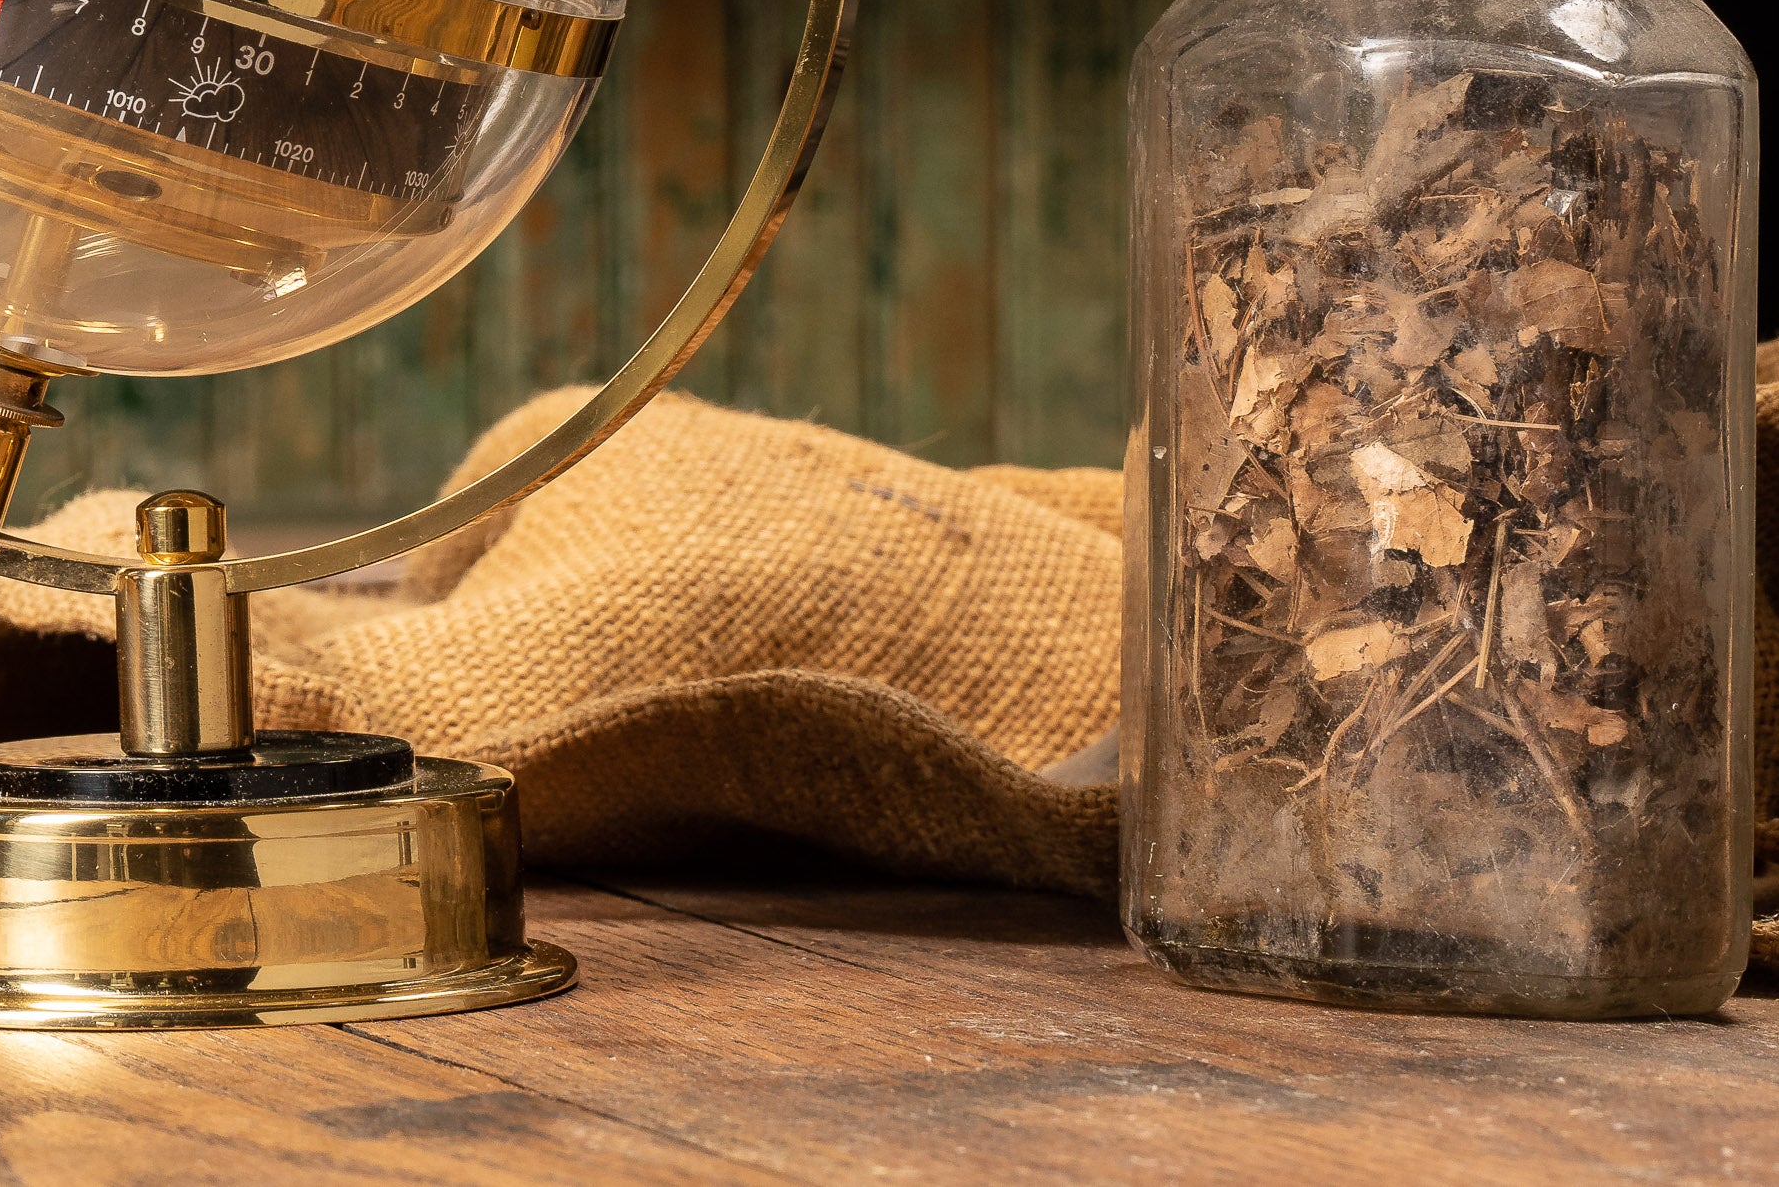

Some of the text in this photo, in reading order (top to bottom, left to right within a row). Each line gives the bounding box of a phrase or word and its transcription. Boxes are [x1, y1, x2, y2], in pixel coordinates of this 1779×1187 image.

[131, 18, 146, 36] 8
[190, 36, 206, 54] 9
[235, 45, 275, 76] 30
[305, 69, 313, 86] 1
[350, 81, 363, 99] 2
[394, 92, 406, 109] 3
[430, 100, 440, 116] 4
[458, 104, 467, 119] 5
[106, 89, 147, 114] 1010
[274, 139, 314, 162] 1020
[405, 170, 430, 188] 1030
